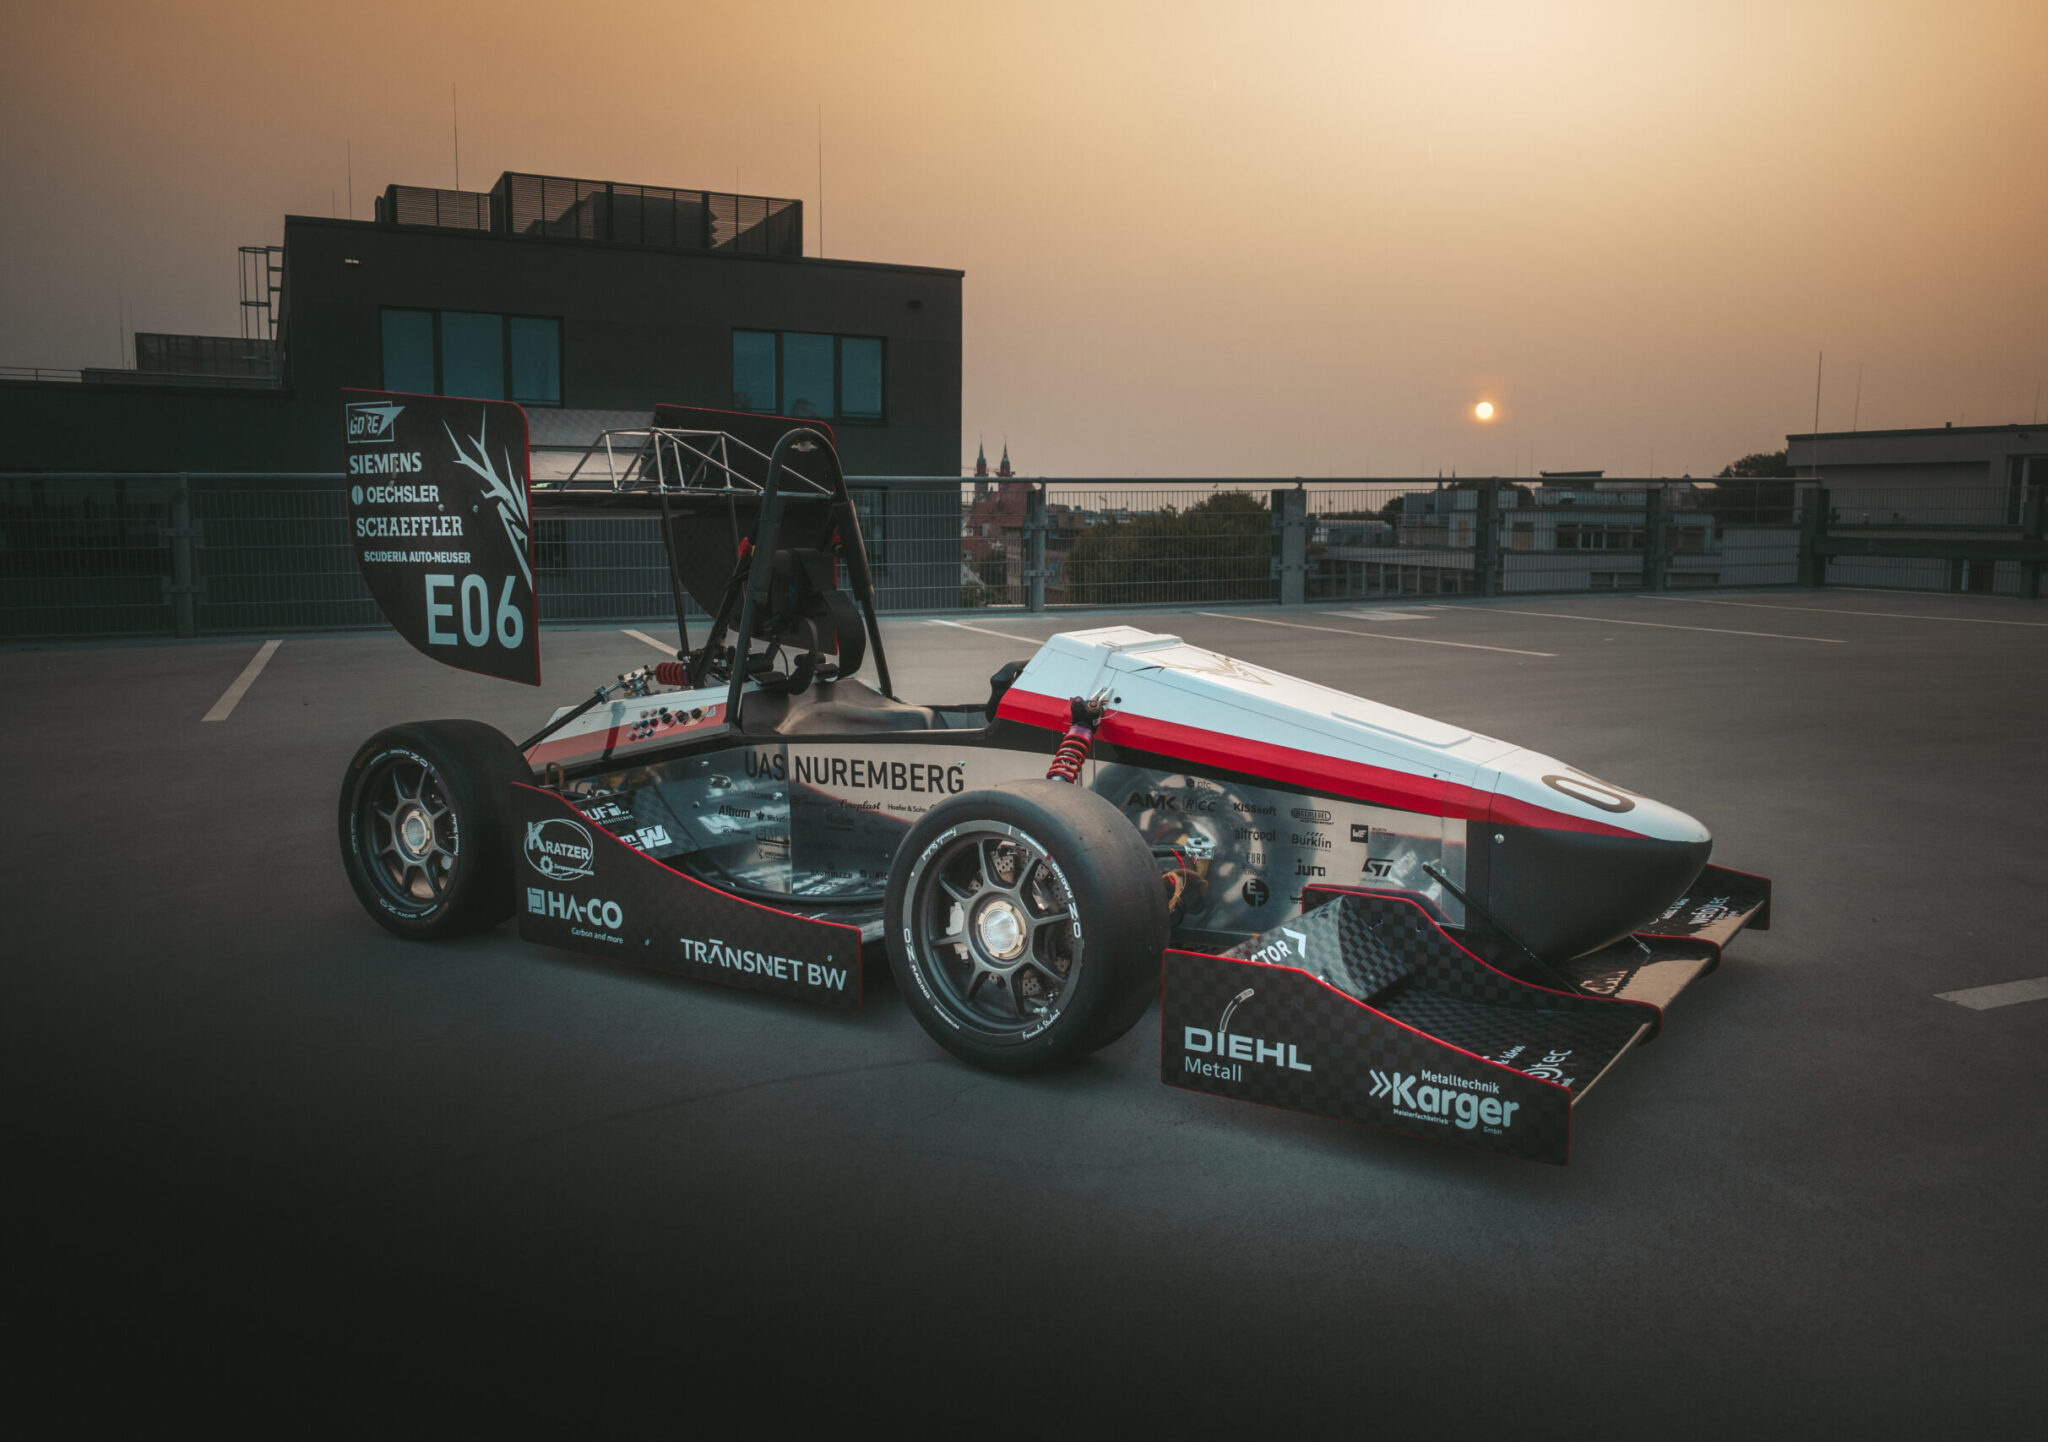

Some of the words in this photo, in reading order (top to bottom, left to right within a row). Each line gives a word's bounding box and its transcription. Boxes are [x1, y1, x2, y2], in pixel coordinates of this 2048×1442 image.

[350, 415, 380, 435] GORE
[349, 452, 422, 474] SIEMENS
[367, 485, 439, 503] OECHSLER
[356, 516, 463, 537] SCHAEFFLER
[364, 551, 407, 562] SCUDERIA
[409, 551, 471, 563] AUTO-NEUSER
[424, 573, 524, 649] E06
[745, 751, 786, 781] UAS
[795, 755, 964, 794] NUREMBERG
[1128, 792, 1177, 811] AMK
[1234, 803, 1277, 815] KISSsoft
[527, 821, 591, 860] KRATZER
[1235, 829, 1276, 842] altropol
[548, 890, 623, 929] HA-CO
[571, 927, 593, 938] Carbon
[594, 933, 606, 941] and
[607, 935, 624, 944] more
[680, 938, 803, 982] TRANSNET
[808, 963, 847, 991] BW
[1184, 1026, 1312, 1072] DIEHL
[1184, 1056, 1243, 1082] Metall
[1422, 1069, 1500, 1094] Metalltechnik
[1392, 1072, 1520, 1130] Karger
[1393, 1108, 1449, 1125] Meisterfachbetrieb
[1483, 1126, 1503, 1135] GmbH
